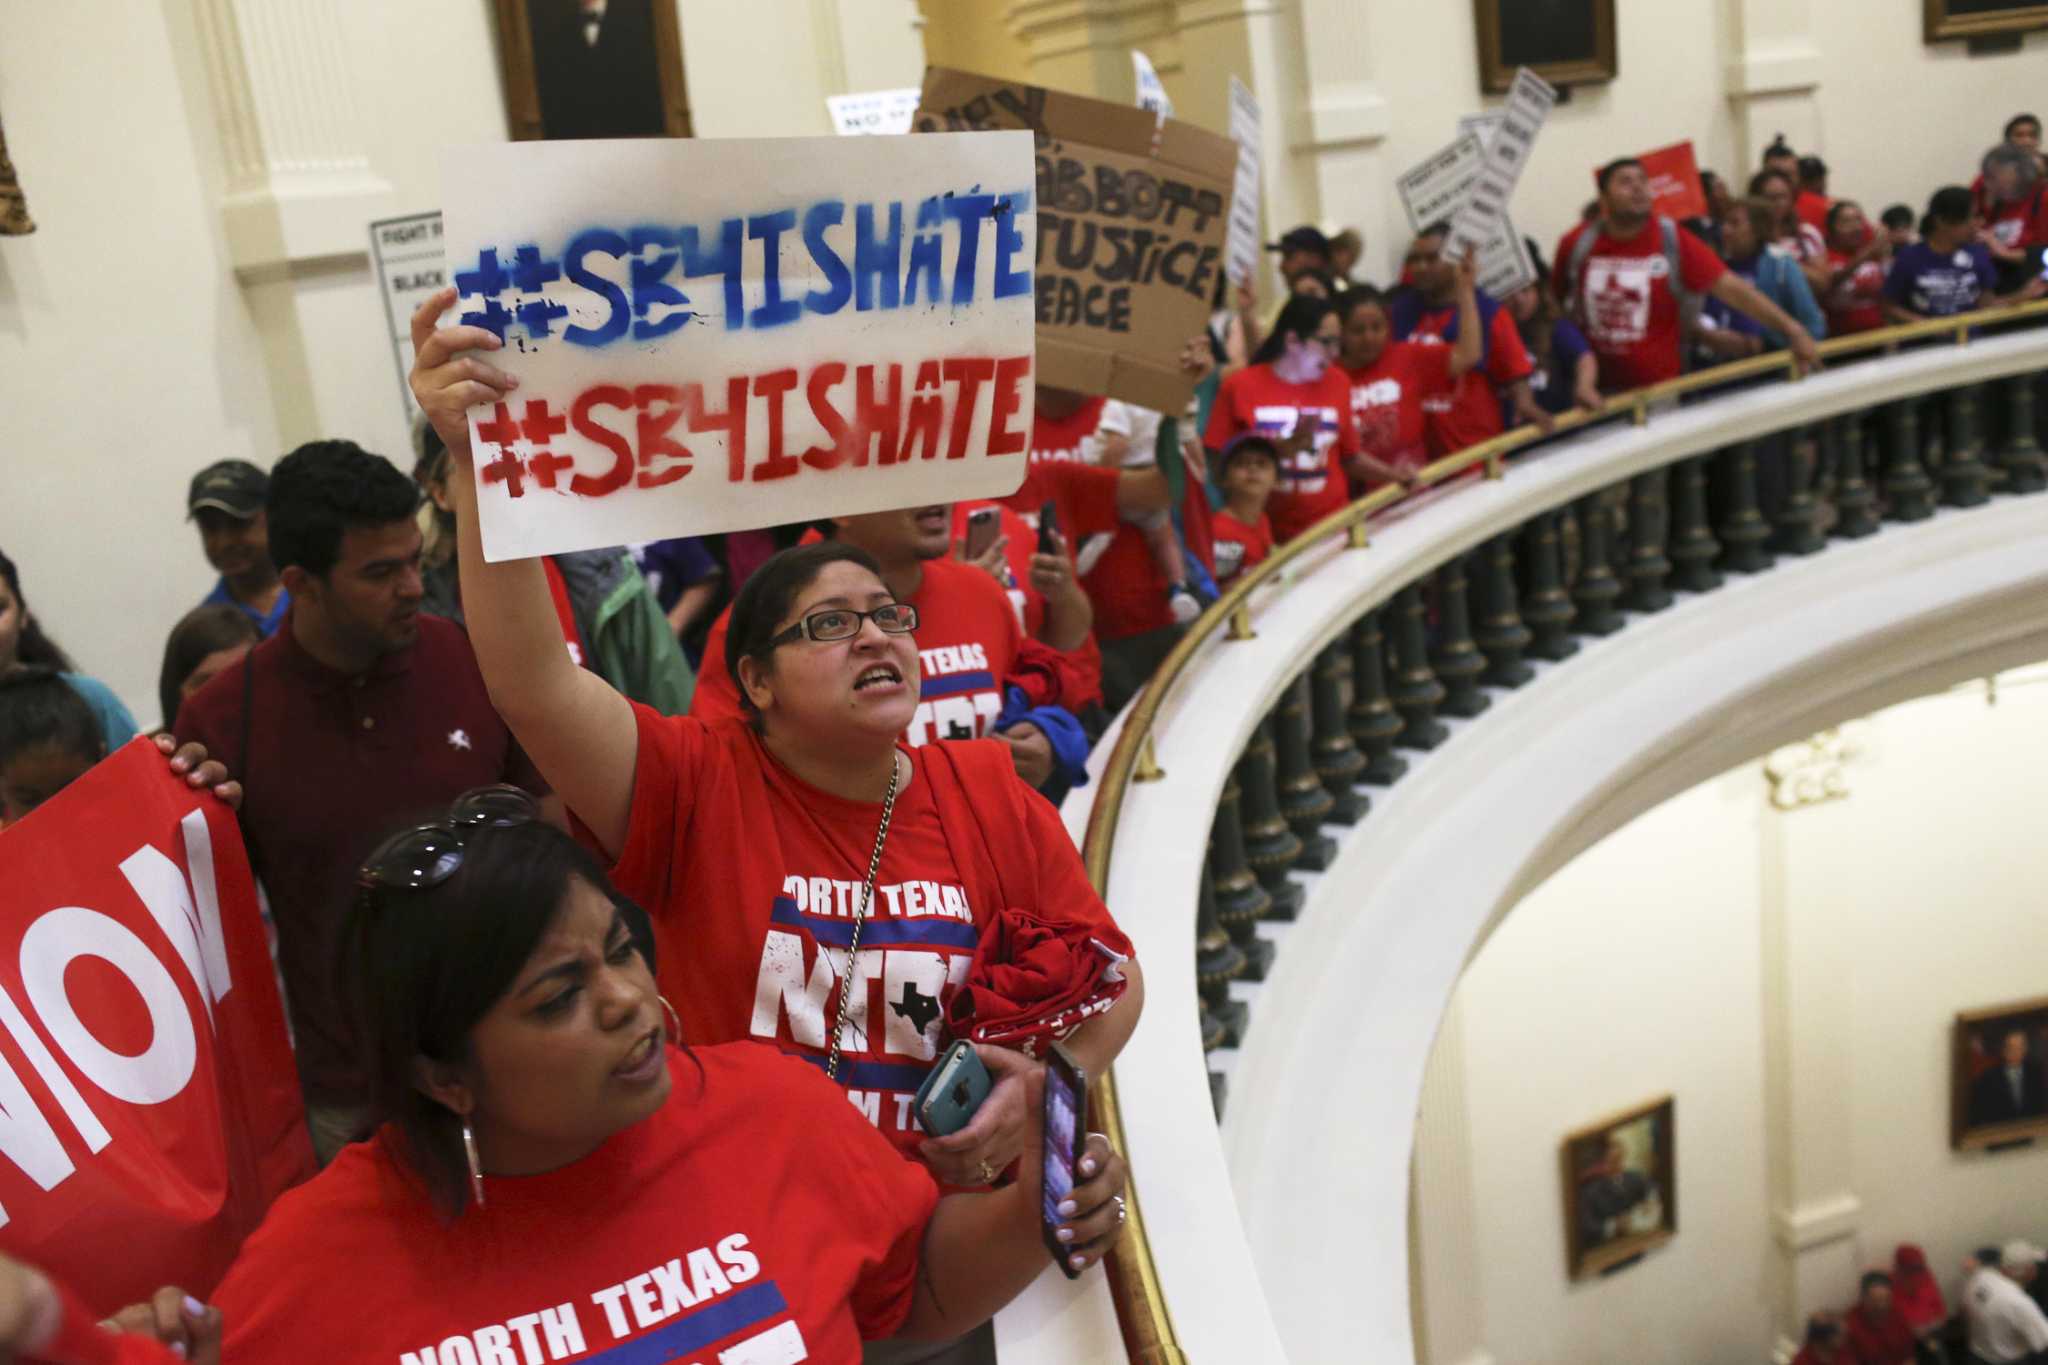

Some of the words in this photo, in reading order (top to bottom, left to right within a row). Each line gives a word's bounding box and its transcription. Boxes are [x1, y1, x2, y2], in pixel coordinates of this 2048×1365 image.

[454, 189, 1032, 346] #SB4ISHATE
[475, 356, 1031, 498] #SB4ISHATE
[919, 643, 989, 676] TEXAS
[783, 874, 876, 919] ORTH
[591, 1232, 760, 1340] TEXAS
